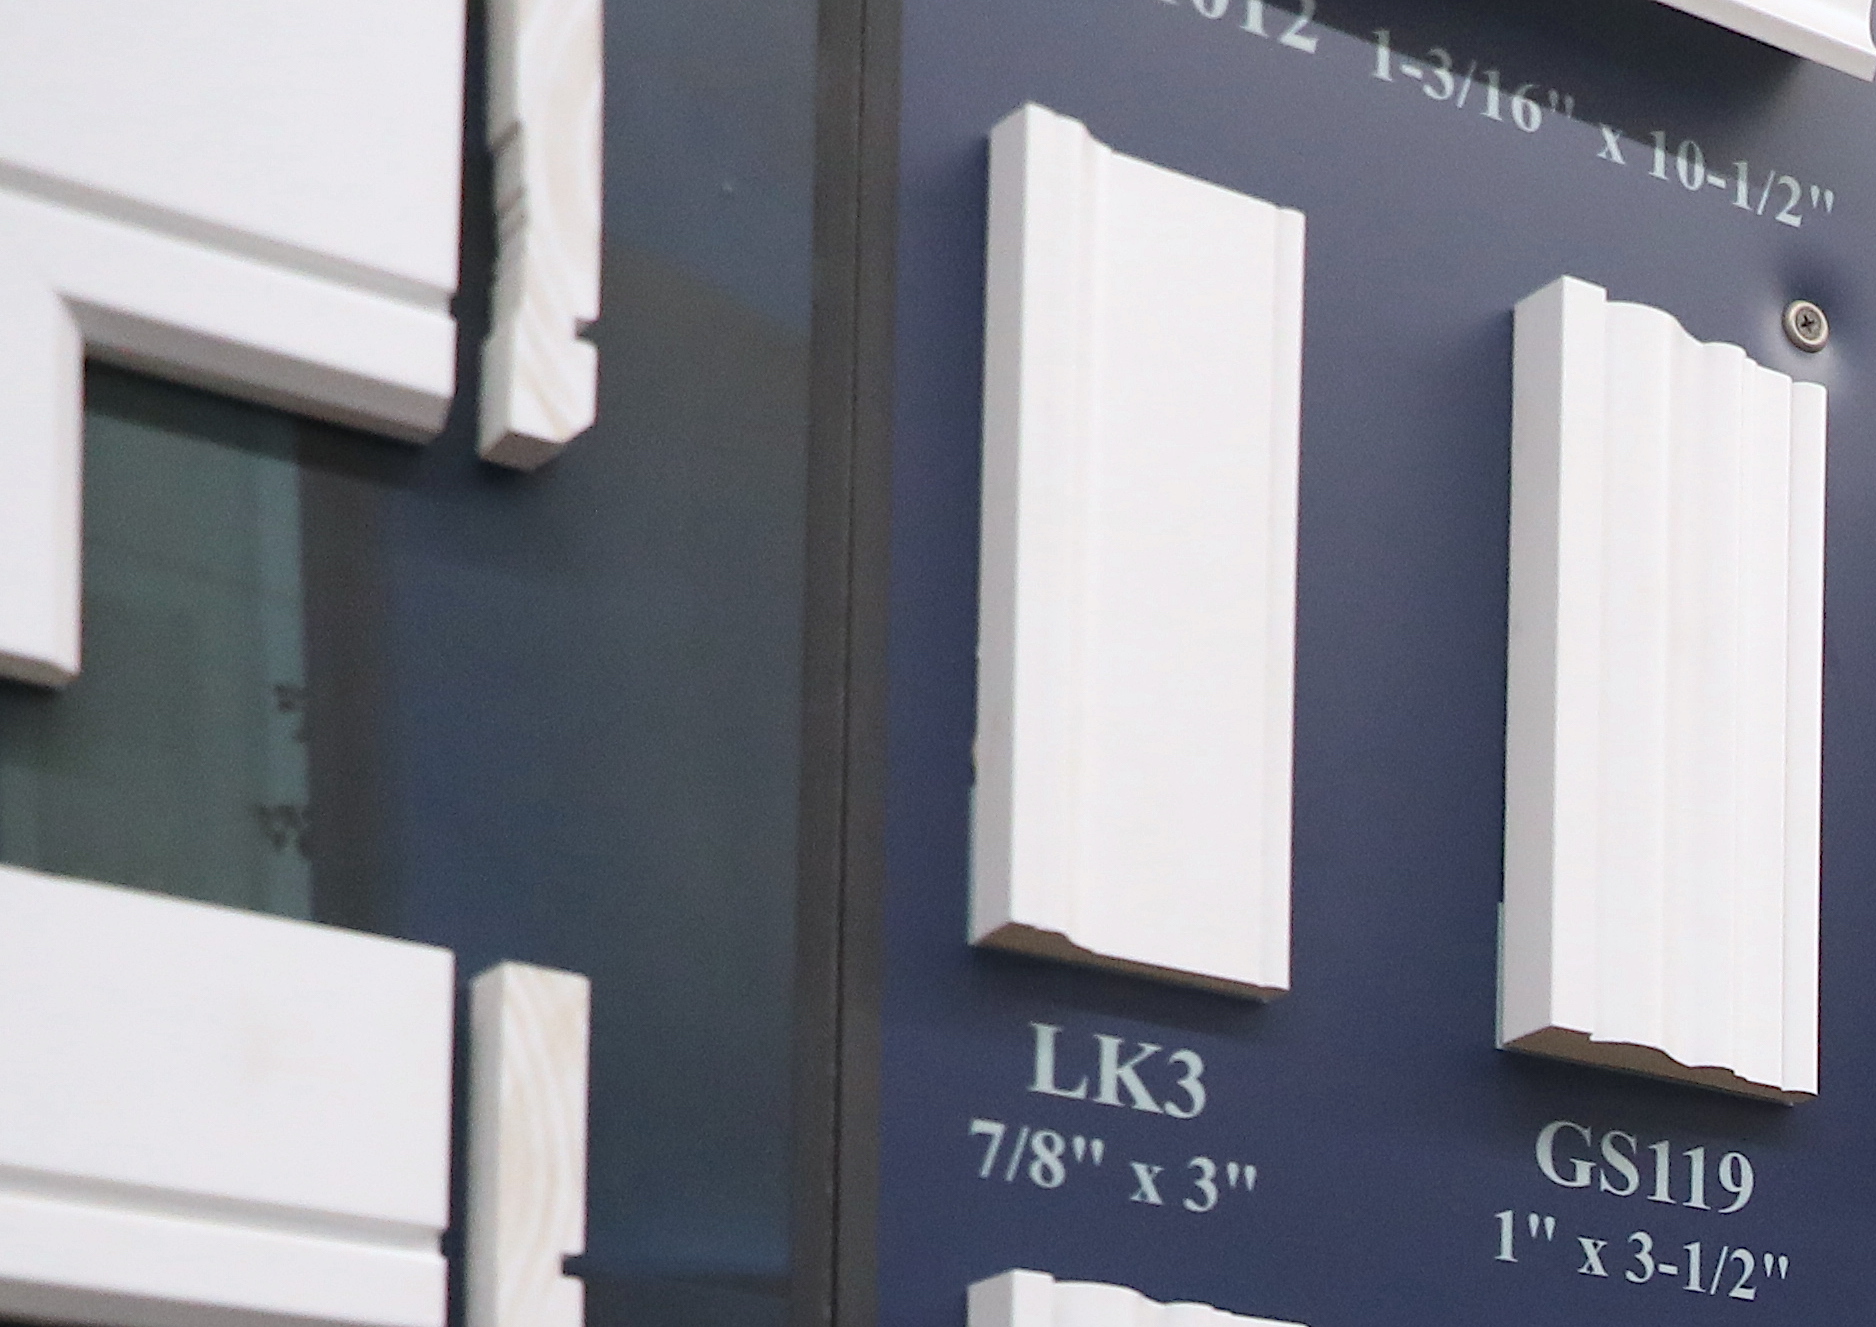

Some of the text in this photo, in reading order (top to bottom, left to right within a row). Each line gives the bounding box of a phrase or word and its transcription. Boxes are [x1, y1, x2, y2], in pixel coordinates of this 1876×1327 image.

[1370, 26, 1573, 133] 1-3/16"
[1597, 126, 1626, 165] x
[1647, 129, 1834, 228] 10-1/2"
[1027, 1020, 1206, 1119] LK3
[969, 1118, 1257, 1212] 7/8" x 3"
[1535, 1120, 1754, 1214] GS119
[1494, 1209, 1789, 1301] 1" x 3-1/2"
